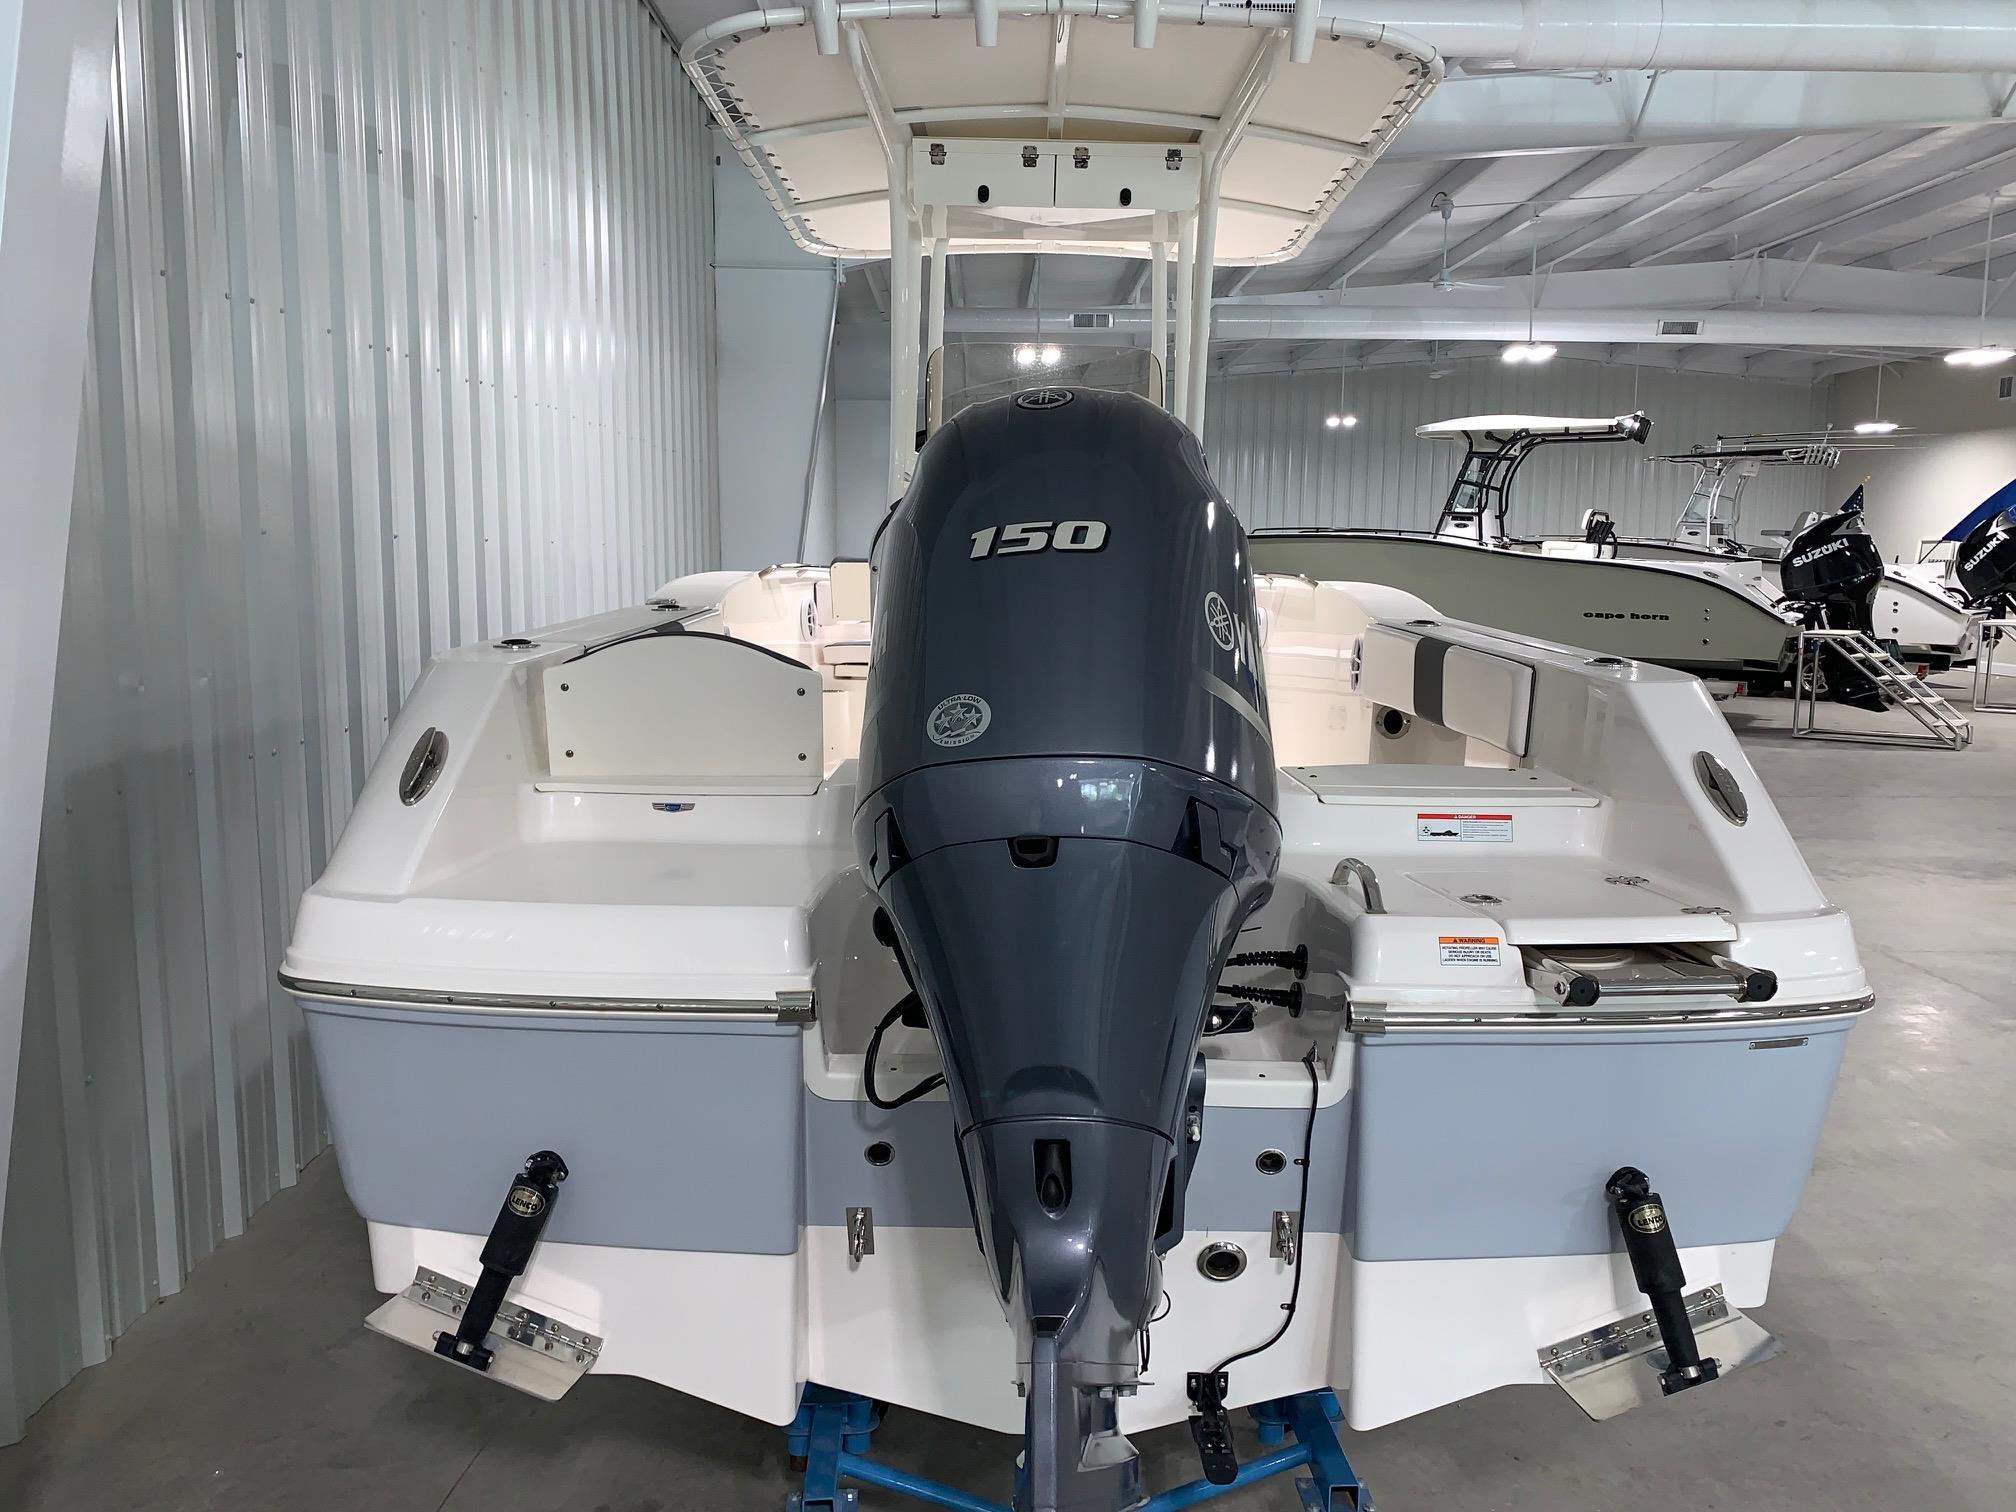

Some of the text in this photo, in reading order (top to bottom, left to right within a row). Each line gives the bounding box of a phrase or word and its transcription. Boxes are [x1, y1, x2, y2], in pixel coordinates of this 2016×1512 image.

[970, 521, 1109, 559] 150
[1792, 538, 1849, 568] SUZUKI
[1964, 534, 2005, 571] SUZUKI
[512, 1195, 538, 1210] LENCO
